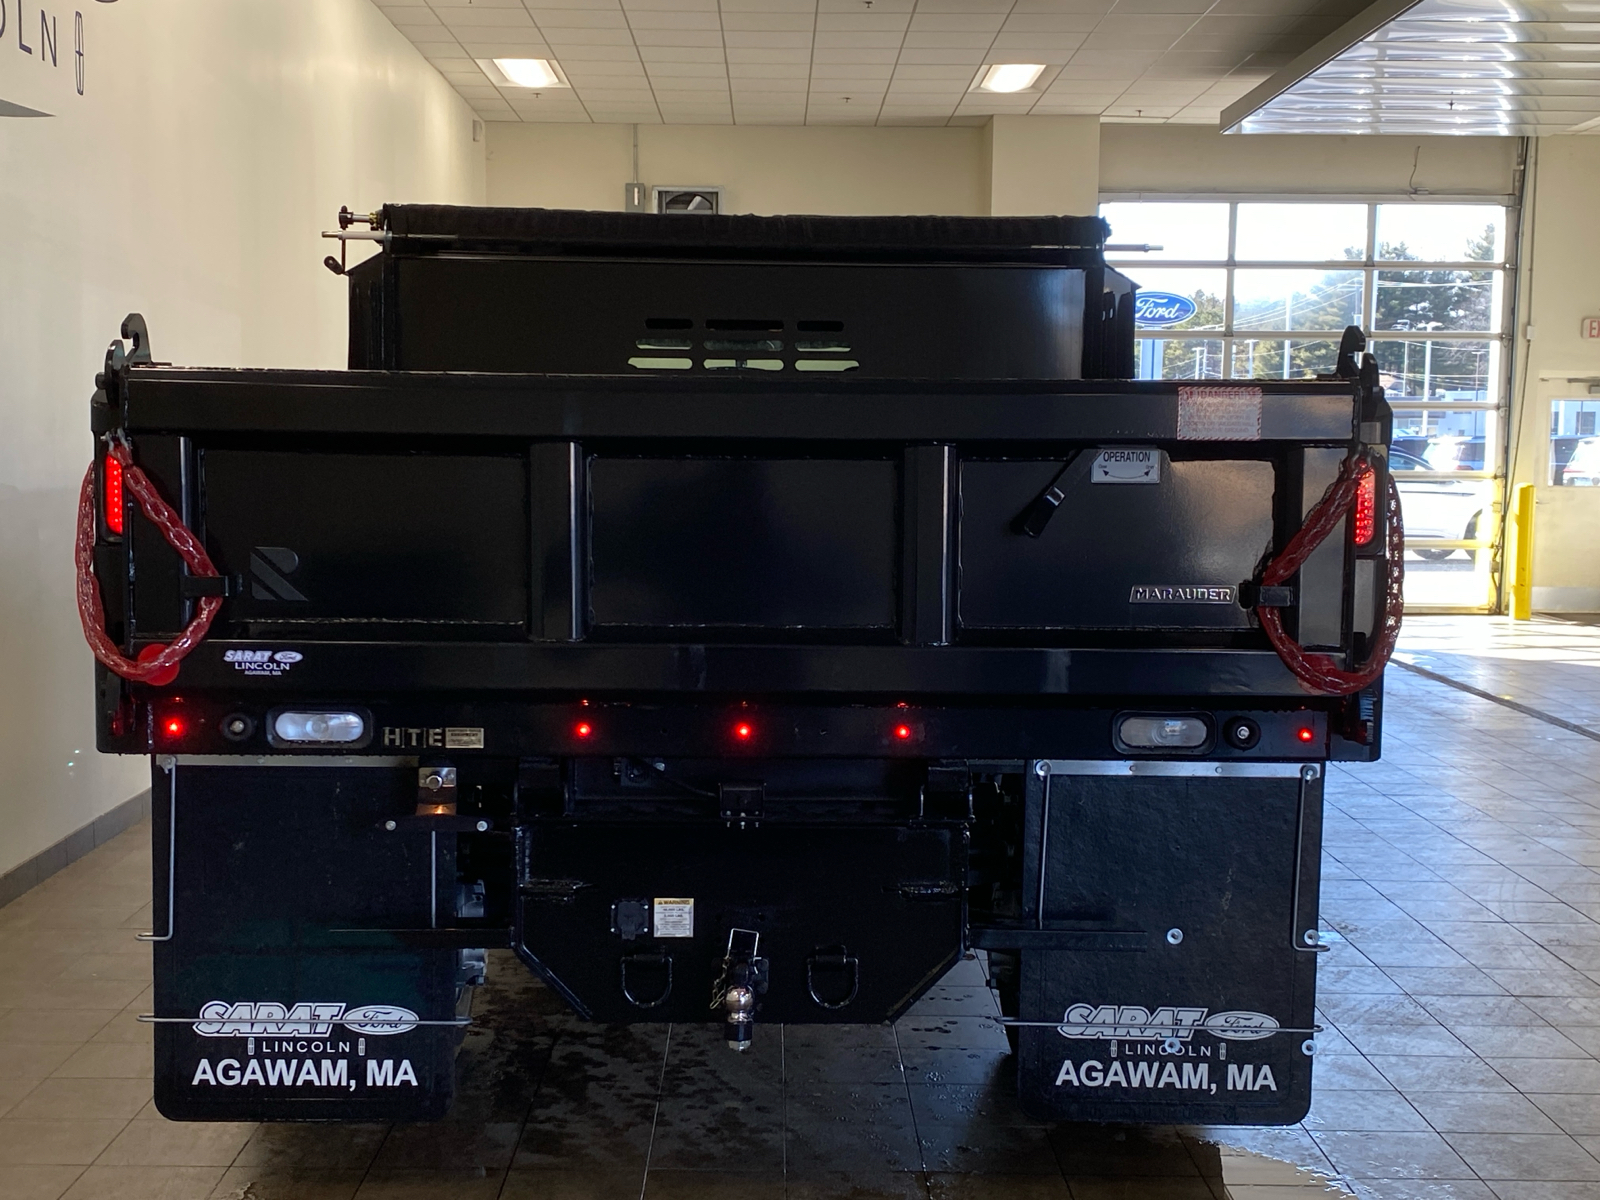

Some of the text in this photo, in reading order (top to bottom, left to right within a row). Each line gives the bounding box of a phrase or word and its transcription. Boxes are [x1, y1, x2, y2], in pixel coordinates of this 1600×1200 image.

[1135, 297, 1181, 318] Ford
[1103, 451, 1151, 462] OPERATION
[1136, 588, 1230, 600] MARAUDER
[224, 650, 272, 662] SARAT
[235, 662, 290, 670] LINCOLN
[193, 1001, 346, 1037] SARAT
[1057, 1003, 1208, 1041] SARAT
[263, 1041, 350, 1053] LINCOLN
[192, 1059, 418, 1092] AGAWAM, MA
[1056, 1060, 1277, 1095] AGAWAM, MA
